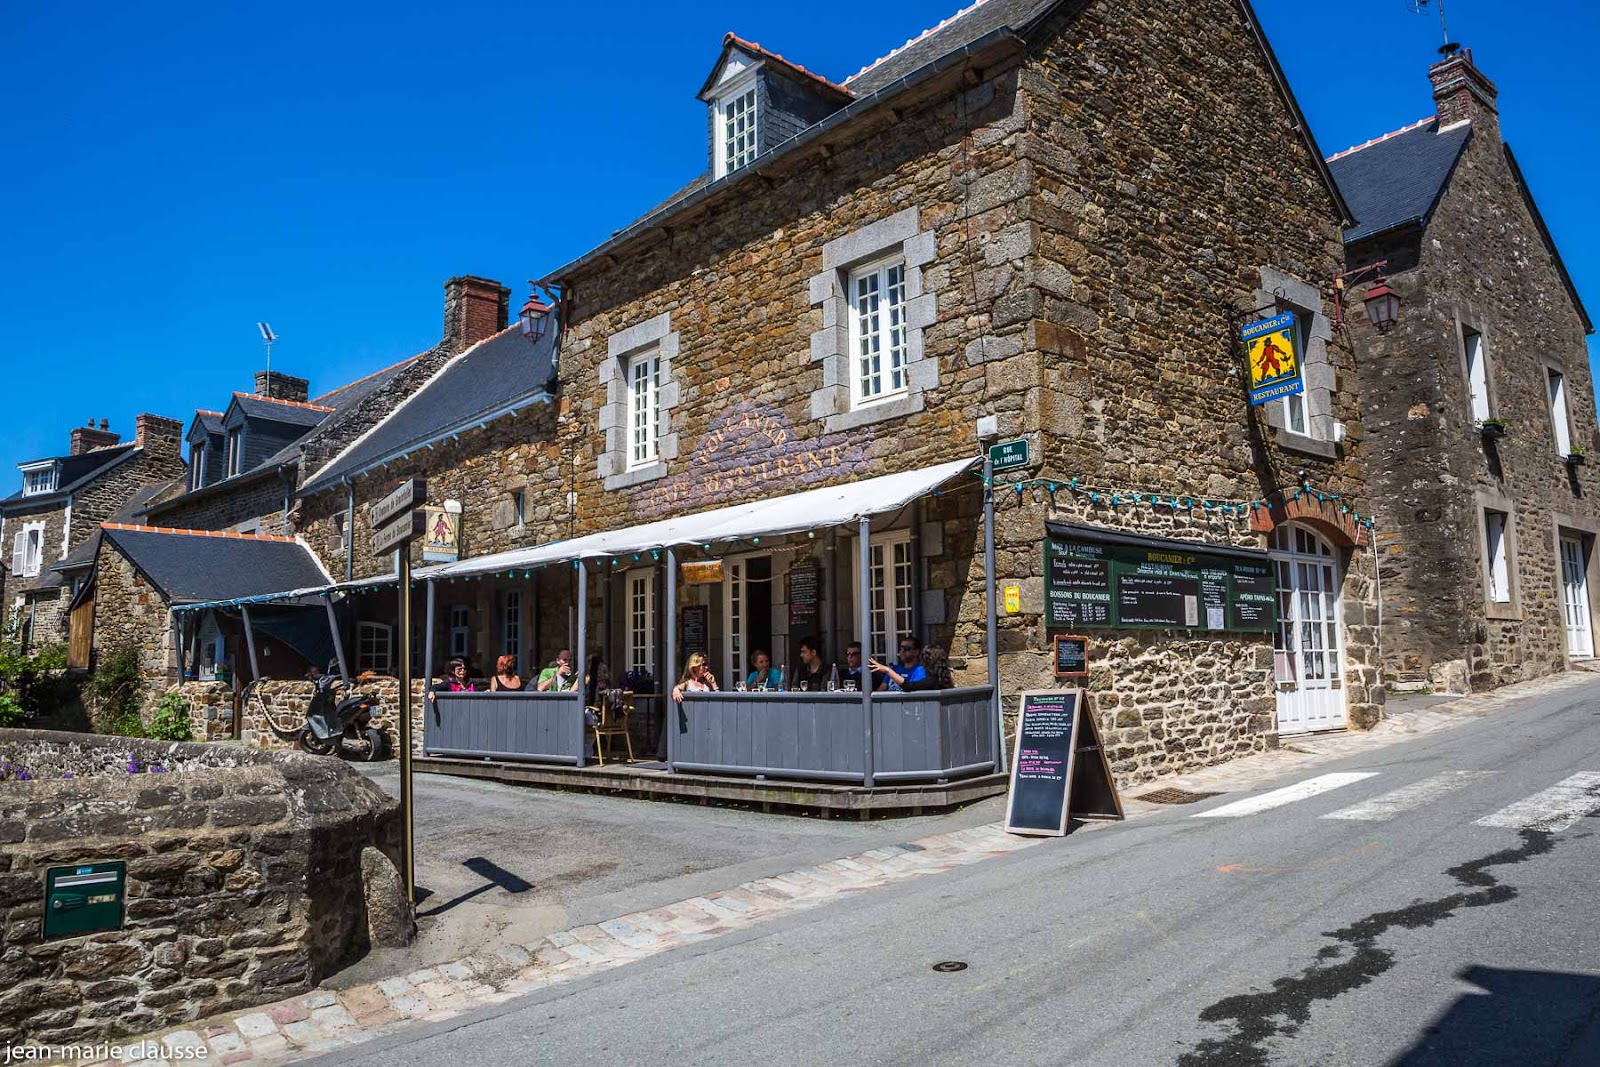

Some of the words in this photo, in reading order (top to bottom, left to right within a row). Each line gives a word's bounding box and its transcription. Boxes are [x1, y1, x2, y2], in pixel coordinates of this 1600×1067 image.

[1243, 319, 1277, 336] BOUCANIER
[1253, 382, 1299, 401] RESTAURANT
[1003, 446, 1013, 454] RUE
[703, 446, 841, 494] RESTAURANT
[1050, 590, 1072, 599] BOISSONS
[1082, 592, 1110, 601] BOUCANIER
